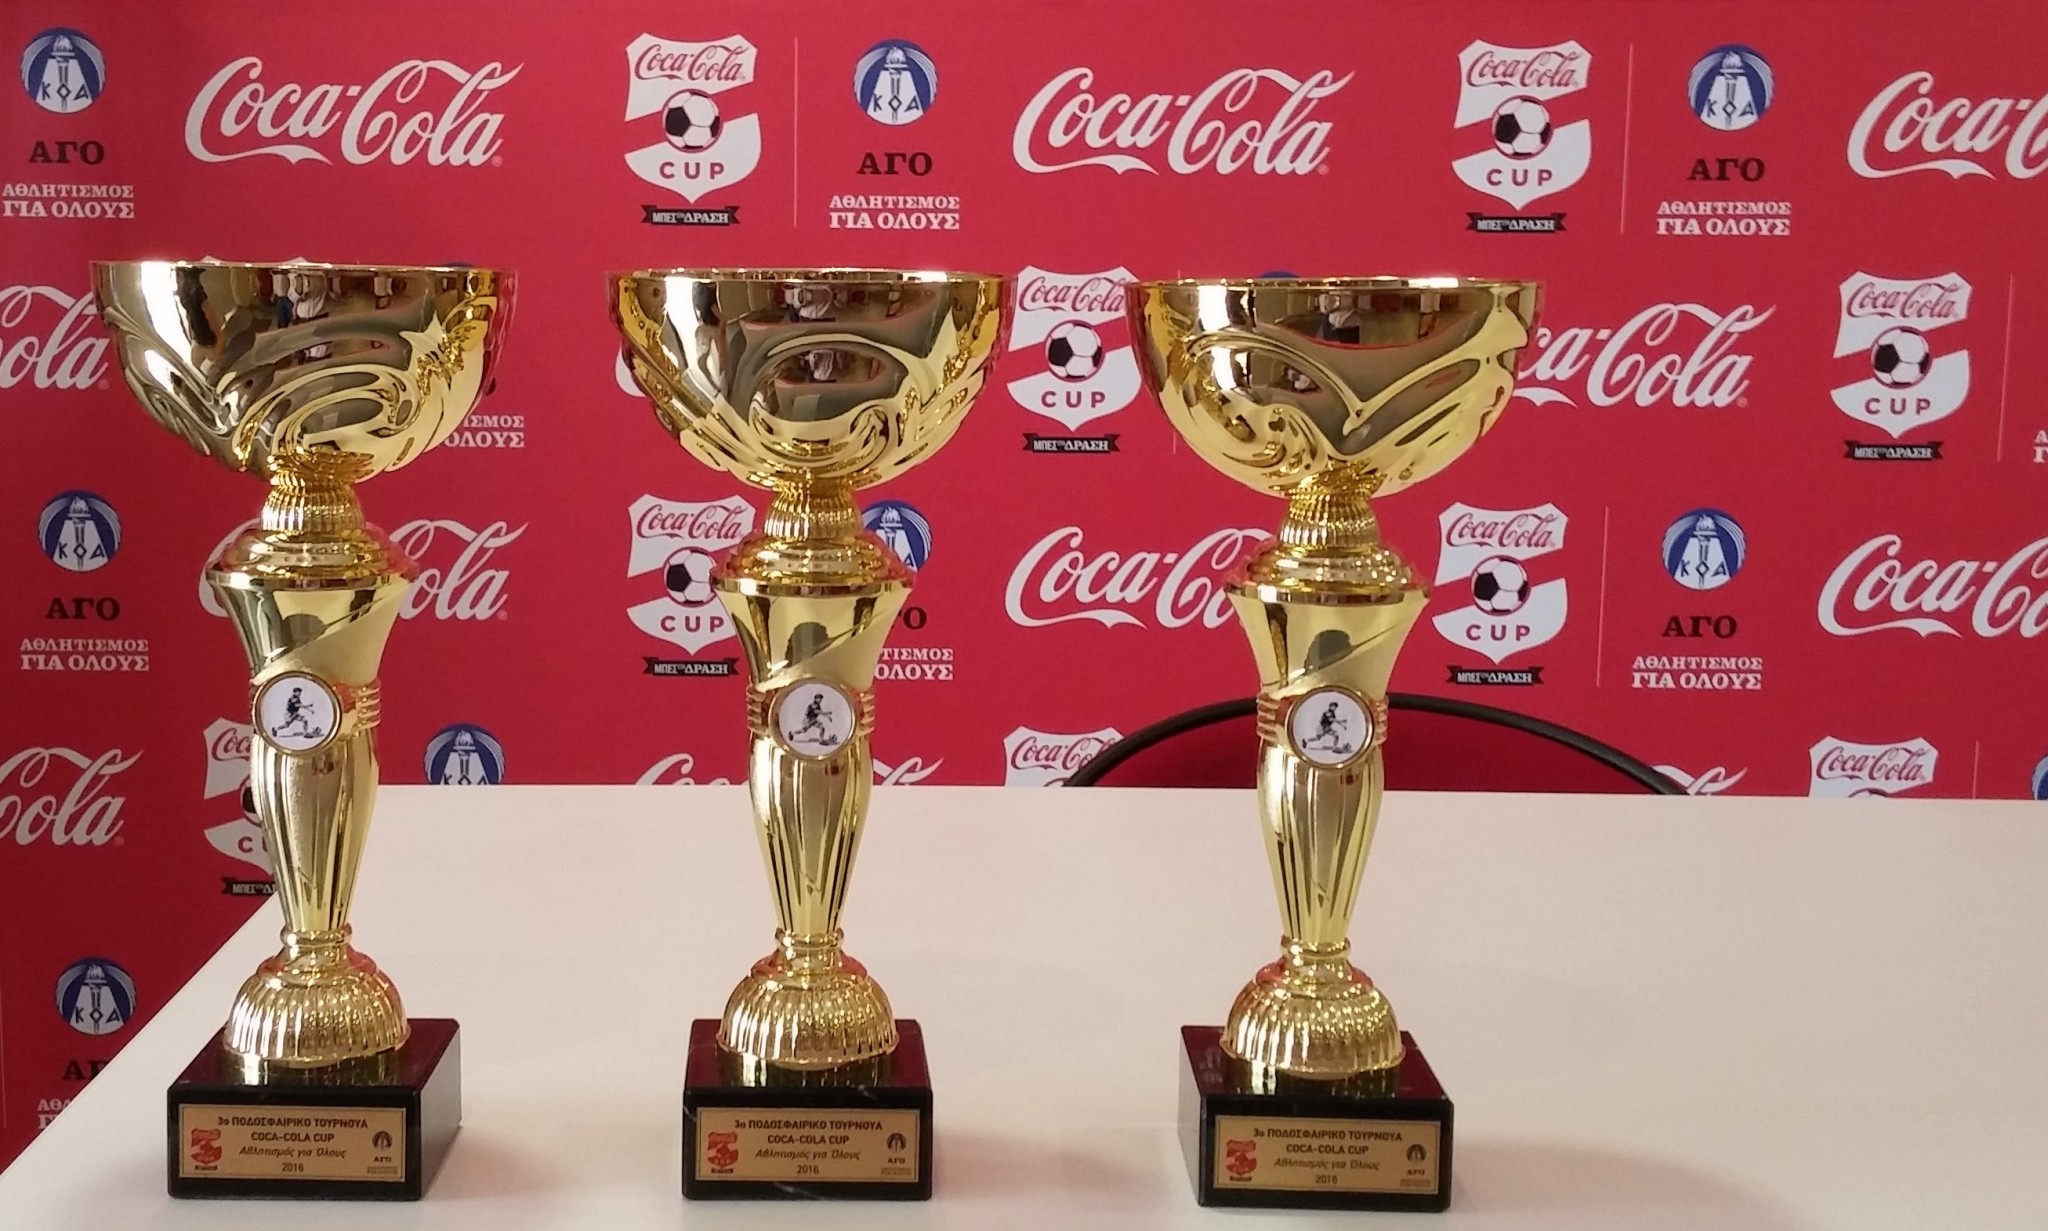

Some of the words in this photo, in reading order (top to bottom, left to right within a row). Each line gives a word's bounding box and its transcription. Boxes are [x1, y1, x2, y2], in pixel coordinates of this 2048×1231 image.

[634, 43, 749, 81] Coca-Cola
[1466, 50, 1581, 88] Coca-Cola
[185, 56, 524, 166] Coca-Cola
[1012, 66, 1354, 175] Coca-Cola
[29, 140, 105, 165] ΑΓΟ
[659, 161, 725, 179] CUP
[858, 152, 932, 176] ΑΓΟ
[1688, 157, 1766, 182] ΑΓΟ
[1486, 168, 1553, 187] CUP
[2, 182, 134, 198] ΑΘΛΗΤΙΣΜΟΣ
[3, 201, 46, 218] ΓΙΑ
[50, 200, 134, 219] ΟΛΟΥΣ
[829, 194, 960, 210] ΑΘΛΗΤΙΣΜΟΣ
[1657, 200, 1792, 216] ΑΘΛΗΤΙΣΜΟΣ
[829, 211, 874, 229] ΓΙΑ
[878, 211, 960, 230] ΟΛΟΥΣ
[1656, 217, 1703, 236] ΓΙΑ
[1706, 217, 1791, 236] ΟΛΟΥΣ
[1019, 276, 1127, 312] Coca-Cola
[1847, 282, 1960, 318] Coca-Cola
[1041, 390, 1106, 408] CUP
[1864, 397, 1931, 416] CUP
[462, 414, 525, 428] ΙΣΜΟΣ
[635, 504, 748, 541] Coca-Cola
[1446, 512, 1563, 549] Coca-Cola
[1817, 534, 2048, 638] Coca-Co
[46, 596, 120, 621] ΑΓΟ
[660, 615, 725, 633] CUP
[1465, 623, 1531, 642] CUP
[1662, 615, 1738, 639] ΑΓΟ
[20, 638, 149, 652] ΑΘΛΗΤΙΣΜΟΣ
[880, 647, 954, 661] ΤΙΣΜΟΣ
[20, 654, 65, 671] ΓΙΑ
[69, 654, 149, 672] ΟΛΟΥΣ
[874, 663, 954, 681] ΟΛΟΥΣ
[1632, 656, 1763, 671] ΑΘΛΗΤΙΣΜΟΣ
[1632, 672, 1676, 689] ΓΙΑ
[1679, 672, 1762, 690] ΟΛΟΥΣ
[1816, 745, 1930, 782] Coca-Cola
[231, 1116, 312, 1128] ΠΟΔΟΣΦΑΙΡΙΚΟ
[313, 1118, 368, 1129] ΤΟΥΡΝΟΥΑ
[748, 1119, 827, 1130] ΠΟΔΟΣΦΑΙΡΙΚΟ
[829, 1121, 882, 1131] ΤΟΥΡΝΟΥΑ
[251, 1132, 312, 1142] COCA-COLA
[313, 1132, 335, 1142] CUP
[767, 1135, 827, 1145] COCA-COLA
[828, 1135, 850, 1145] CUP
[1267, 1129, 1346, 1140] ΠΟΔΟΣΦΑΙΡΙΚΟ
[1349, 1130, 1402, 1141] ΤΟΥΡΝΟΥΑ
[1286, 1144, 1347, 1155] COCA-COLA
[1348, 1145, 1369, 1155] CUP
[282, 1163, 304, 1172] 2016
[797, 1165, 819, 1174] 2016
[1315, 1175, 1338, 1184] 2016
